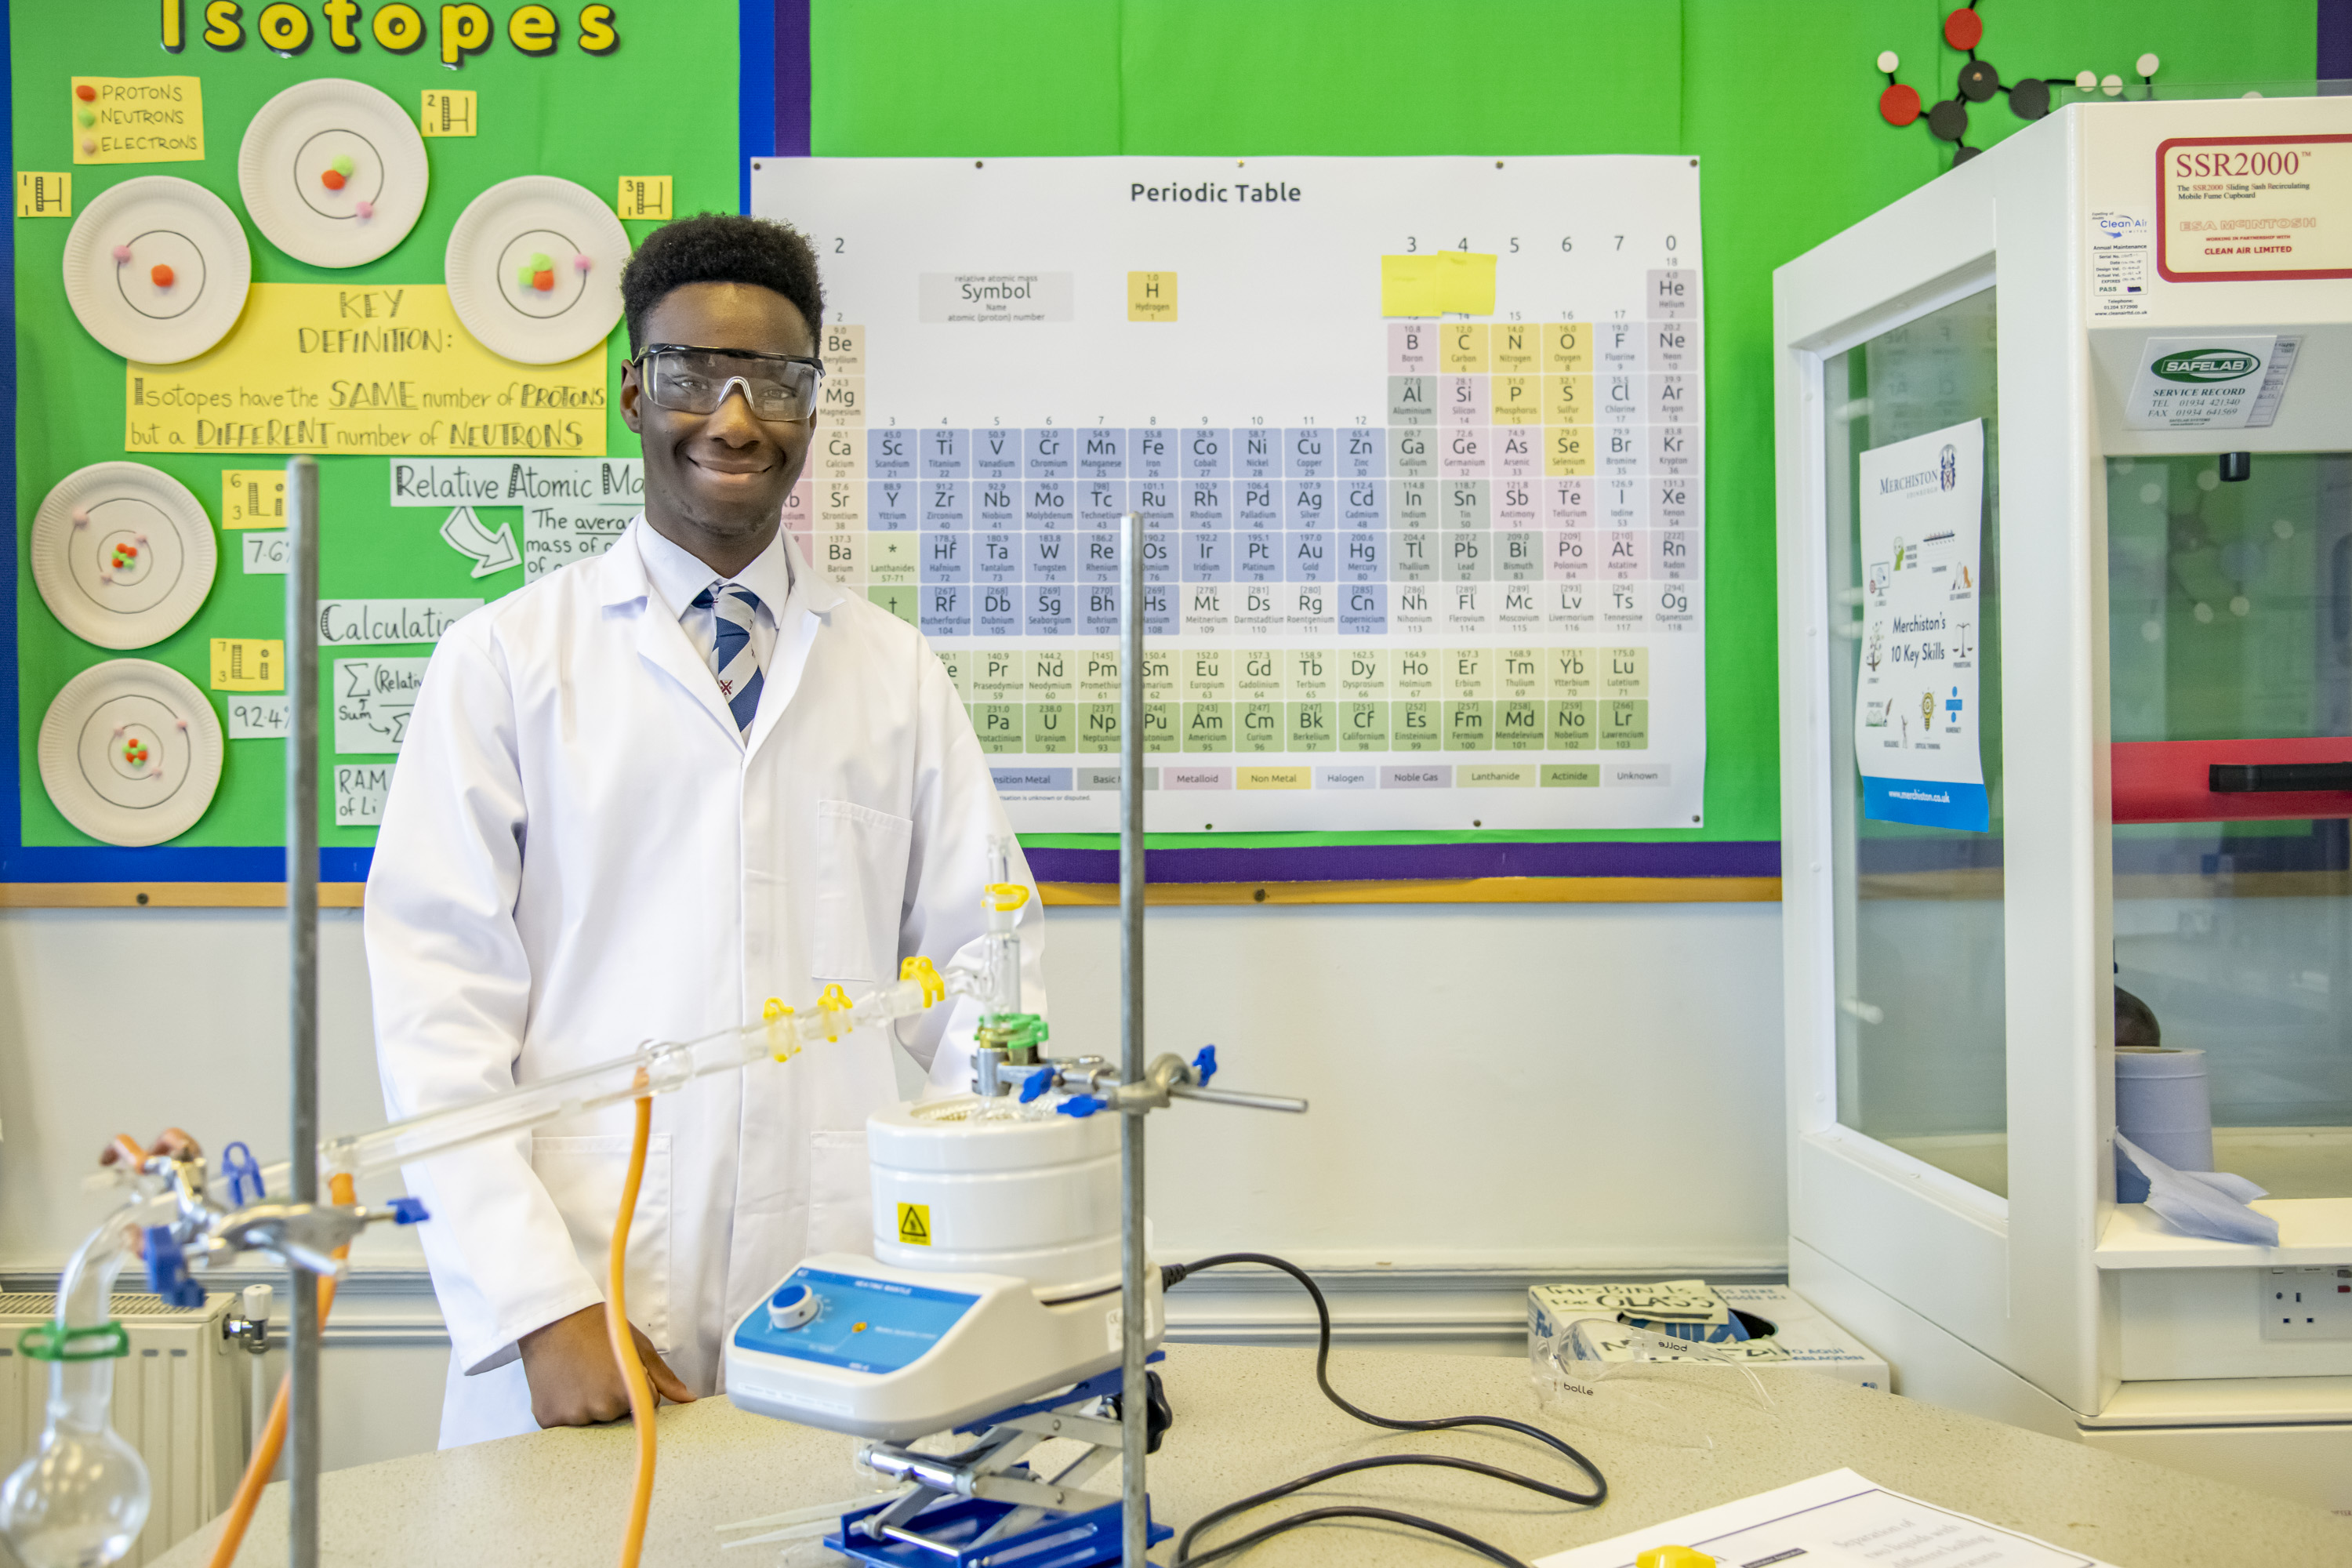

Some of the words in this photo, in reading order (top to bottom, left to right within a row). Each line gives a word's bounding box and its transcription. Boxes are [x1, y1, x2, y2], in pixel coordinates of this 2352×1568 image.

[161, 0, 621, 70] Isotopes
[101, 85, 183, 103] PROTONS
[426, 94, 436, 107] 2
[100, 107, 185, 126] NEUTRONS
[100, 134, 198, 153] ELECTRONS
[2176, 151, 2299, 177] SSR2000
[626, 180, 633, 192] 3
[1131, 183, 1228, 203] Periodic
[1236, 183, 1301, 203] Table
[2180, 221, 2217, 231] ESA
[834, 238, 844, 254] 2
[1666, 236, 1676, 251] 0
[961, 281, 1032, 303] Symbol
[1146, 283, 1159, 298] H
[1659, 281, 1684, 296] He
[339, 289, 405, 319] KEY
[1135, 303, 1170, 312] Hydrogen
[978, 314, 1011, 322] (proton)
[298, 327, 452, 355] DEFINITION:
[1458, 334, 1470, 350] C
[1509, 335, 1522, 350] N
[1560, 334, 1575, 350] O
[1660, 332, 1686, 348] Ne
[2166, 361, 2245, 371] SAFELAB
[134, 377, 232, 410] Isotopes
[239, 387, 285, 408] have
[289, 387, 319, 408] the
[329, 381, 419, 410] SAME
[423, 388, 492, 408] number
[498, 384, 520, 408] of
[521, 384, 605, 409] PROTONS
[826, 389, 855, 407] Mg
[1662, 385, 1682, 401] Ar
[131, 424, 165, 445] but
[170, 431, 185, 445] a
[194, 421, 333, 448] DIFFERENT
[336, 425, 411, 447] number
[419, 422, 442, 446] of
[450, 423, 583, 450] NEUTRONS
[829, 440, 851, 456] Ca
[1143, 440, 1164, 455] Fe
[1298, 440, 1321, 455] Cu
[1349, 440, 1372, 455] Zn
[1611, 438, 1632, 452] Br
[1297, 459, 1322, 469] Copper
[230, 474, 241, 488] 6
[396, 465, 499, 499] Relative
[508, 463, 593, 498] Atomic
[602, 463, 644, 495] Ma
[249, 482, 284, 517] Li
[1298, 492, 1322, 510] Ag
[233, 505, 241, 520] 3
[532, 508, 568, 529] The
[575, 517, 633, 531] avera
[526, 540, 572, 552] mass
[579, 537, 598, 552] of
[1298, 544, 1323, 558] Au
[1350, 543, 1375, 561] Hg
[528, 557, 547, 573] of
[1348, 564, 1377, 572] Mercury
[1661, 593, 1687, 612] Og
[321, 604, 456, 642] Calculati
[1893, 612, 1945, 634] Merchiston's
[232, 644, 269, 680] Li
[1891, 644, 1901, 662] 10
[1904, 644, 1919, 668] Key
[1922, 641, 1944, 660] Skills
[219, 671, 227, 682] 3
[339, 706, 372, 720] Sum
[1559, 711, 1584, 727] No
[1044, 714, 1056, 729] U
[1177, 775, 1218, 783] Metalloid
[1327, 774, 1364, 785] Halogen
[1394, 773, 1418, 782] Noble
[1422, 773, 1438, 782] Gas
[1471, 771, 1519, 781] Lanthanide
[1552, 771, 1588, 781] Actinide
[1889, 789, 1950, 803] www.merchiston.co.uk
[339, 797, 356, 816] of
[361, 797, 377, 815] Li
[1596, 1295, 1715, 1308] GLASS
